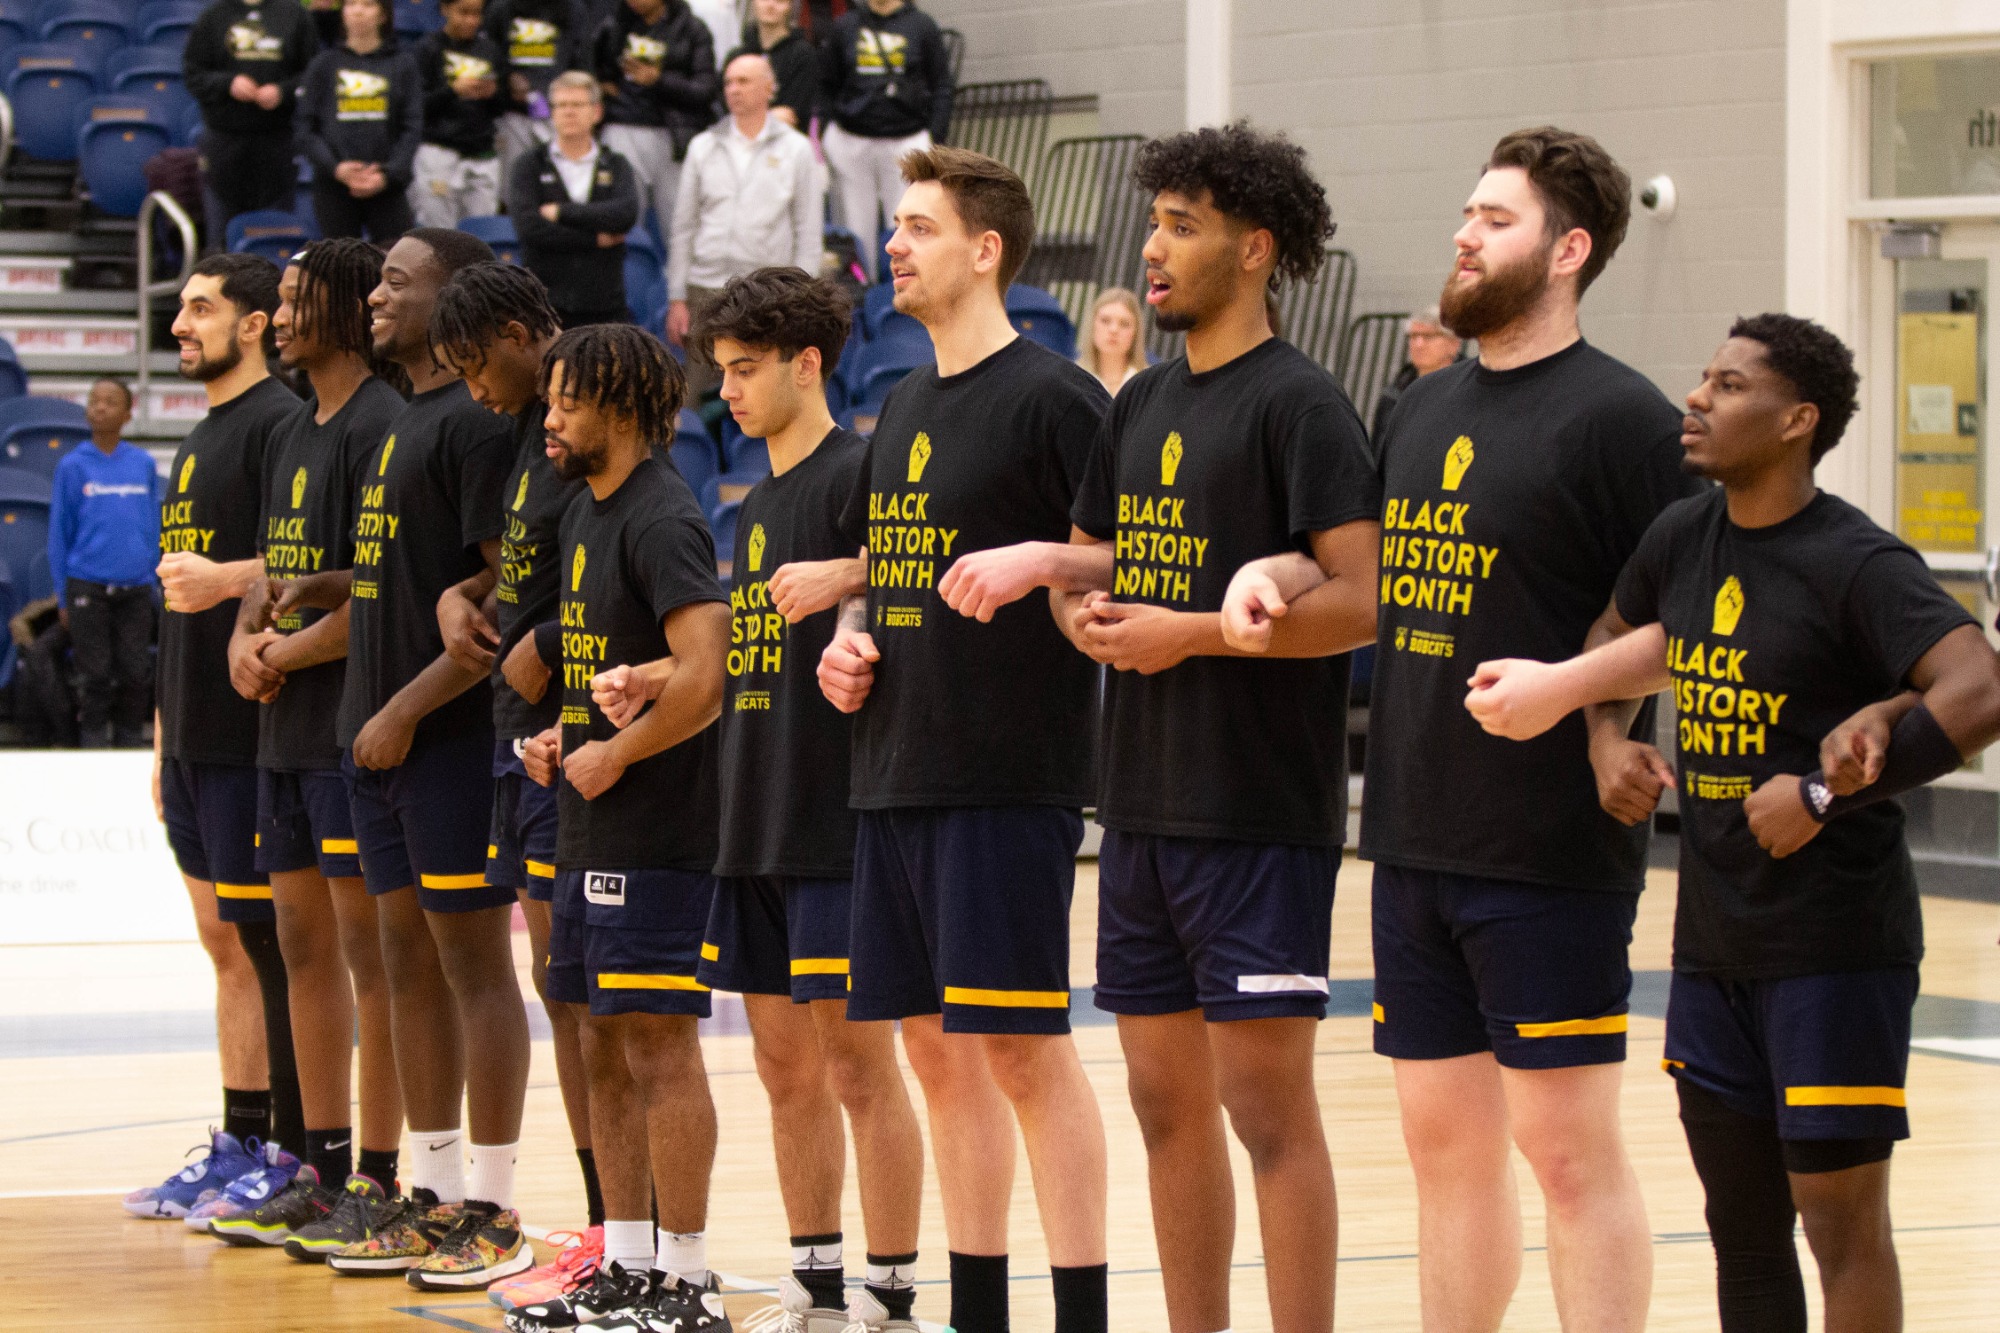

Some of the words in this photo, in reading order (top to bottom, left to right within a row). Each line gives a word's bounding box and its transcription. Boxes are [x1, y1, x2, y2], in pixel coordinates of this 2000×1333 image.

[162, 500, 193, 527] LACK
[868, 492, 930, 521] BLACK
[1118, 494, 1185, 529] BLACK
[1384, 498, 1470, 536] BLACK
[868, 526, 959, 557] HISTORY
[1382, 536, 1500, 579] HISTORY
[1409, 637, 1455, 658] BOBCATS
[562, 711, 590, 725] OBCATS
[1679, 717, 1766, 756] ONTH
